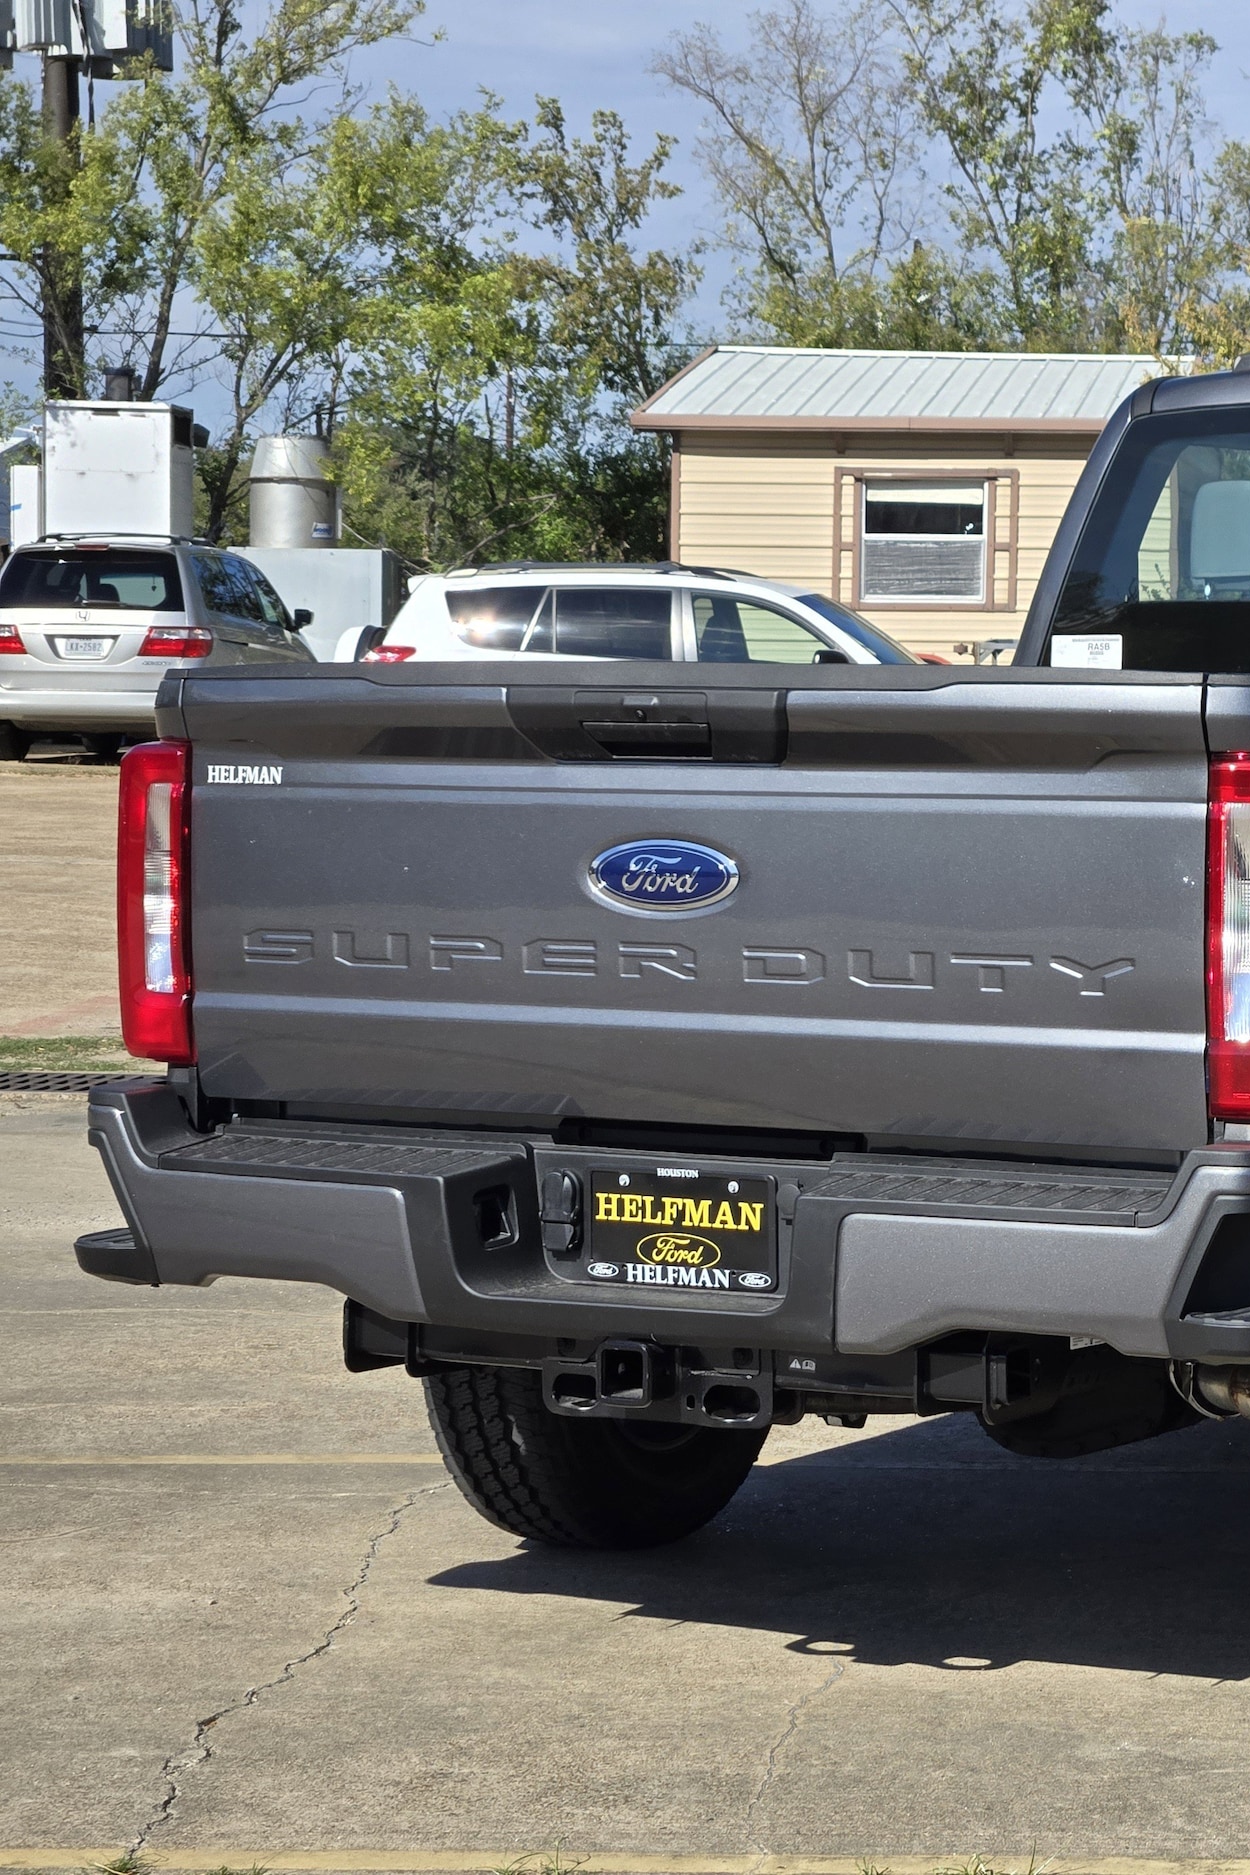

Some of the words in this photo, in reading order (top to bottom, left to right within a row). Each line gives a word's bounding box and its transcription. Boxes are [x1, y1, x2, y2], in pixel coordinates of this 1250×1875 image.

[207, 765, 283, 784] HELFMAN
[621, 854, 702, 894] Ford
[243, 928, 698, 981] SUPER
[742, 945, 1136, 997] DUTY
[656, 1167, 699, 1179] HOUSTON
[595, 1192, 765, 1232] HELFMAN
[651, 1236, 704, 1265] Ford
[625, 1262, 731, 1289] HELFMAN
